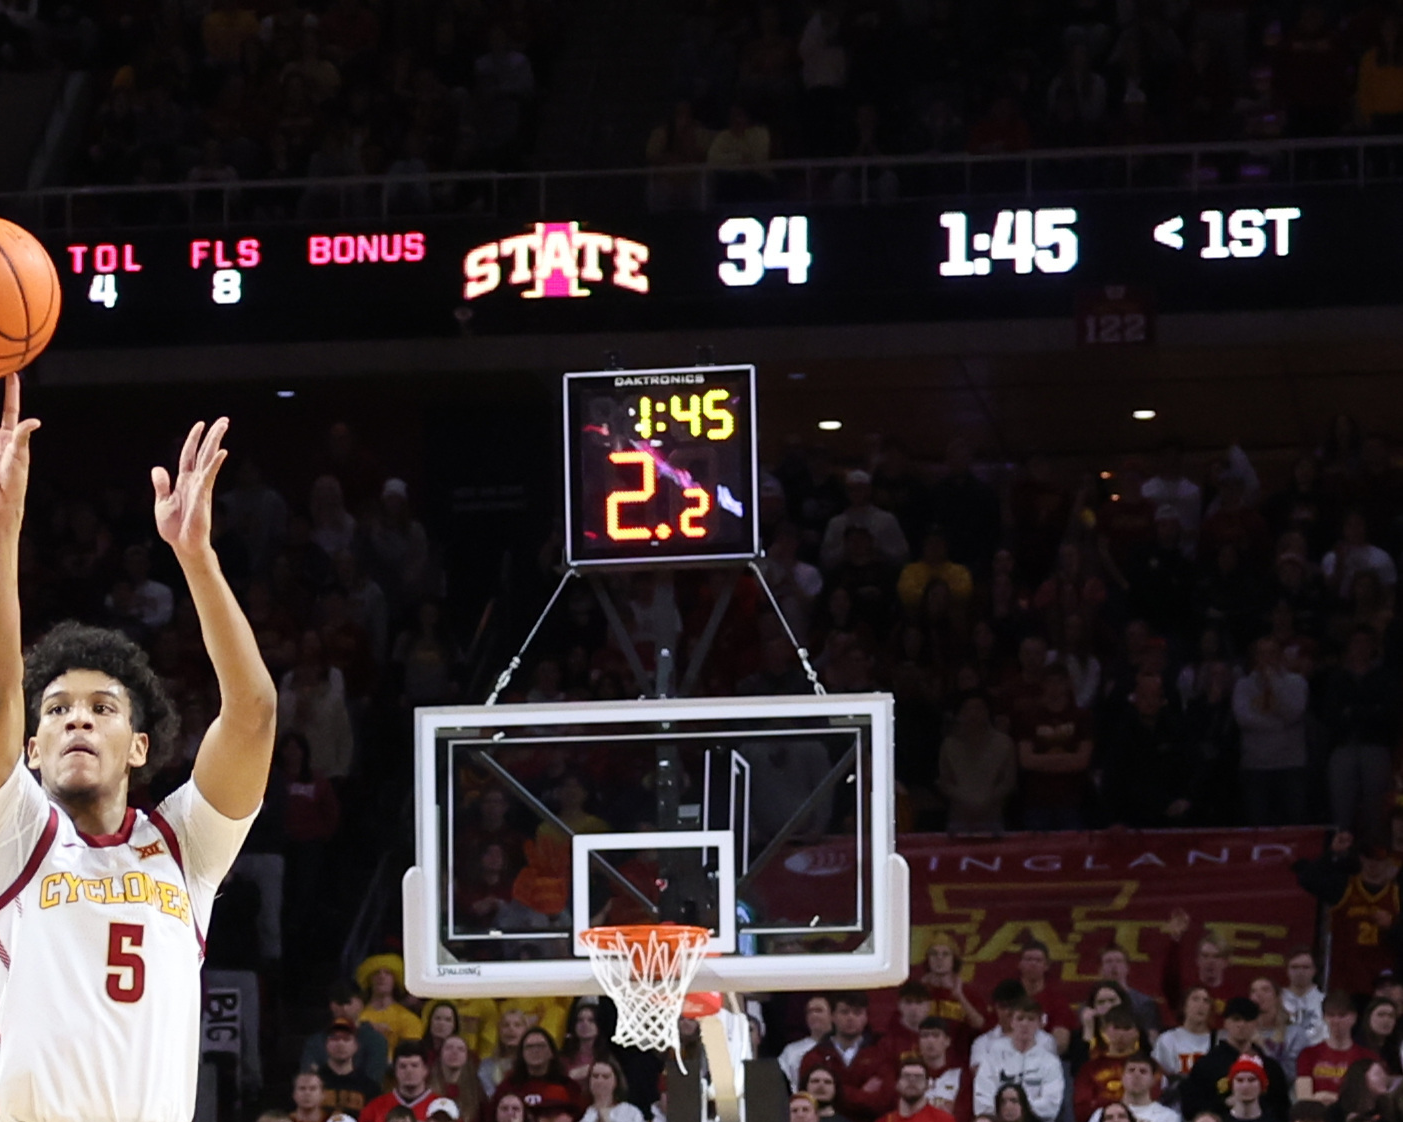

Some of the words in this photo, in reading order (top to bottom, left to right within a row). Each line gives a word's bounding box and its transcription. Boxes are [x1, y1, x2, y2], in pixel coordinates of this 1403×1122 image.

[190, 239, 260, 269] FLS
[308, 233, 425, 264] BONUS
[718, 215, 811, 287] 34
[939, 209, 1078, 276] 1:45
[1200, 207, 1300, 259] 1ST
[68, 245, 142, 273] TOL
[463, 228, 650, 300] STATE
[89, 275, 117, 308] 4
[212, 270, 241, 304] 8
[1085, 313, 1146, 344] 122
[614, 374, 705, 387] DAKTRONICS
[639, 388, 734, 440] 1:45
[607, 451, 711, 540] 2.2
[929, 844, 1294, 873] INGLAND
[39, 871, 191, 927] CYCLONES
[106, 922, 146, 1004] 5
[206, 992, 239, 1042] BIG
